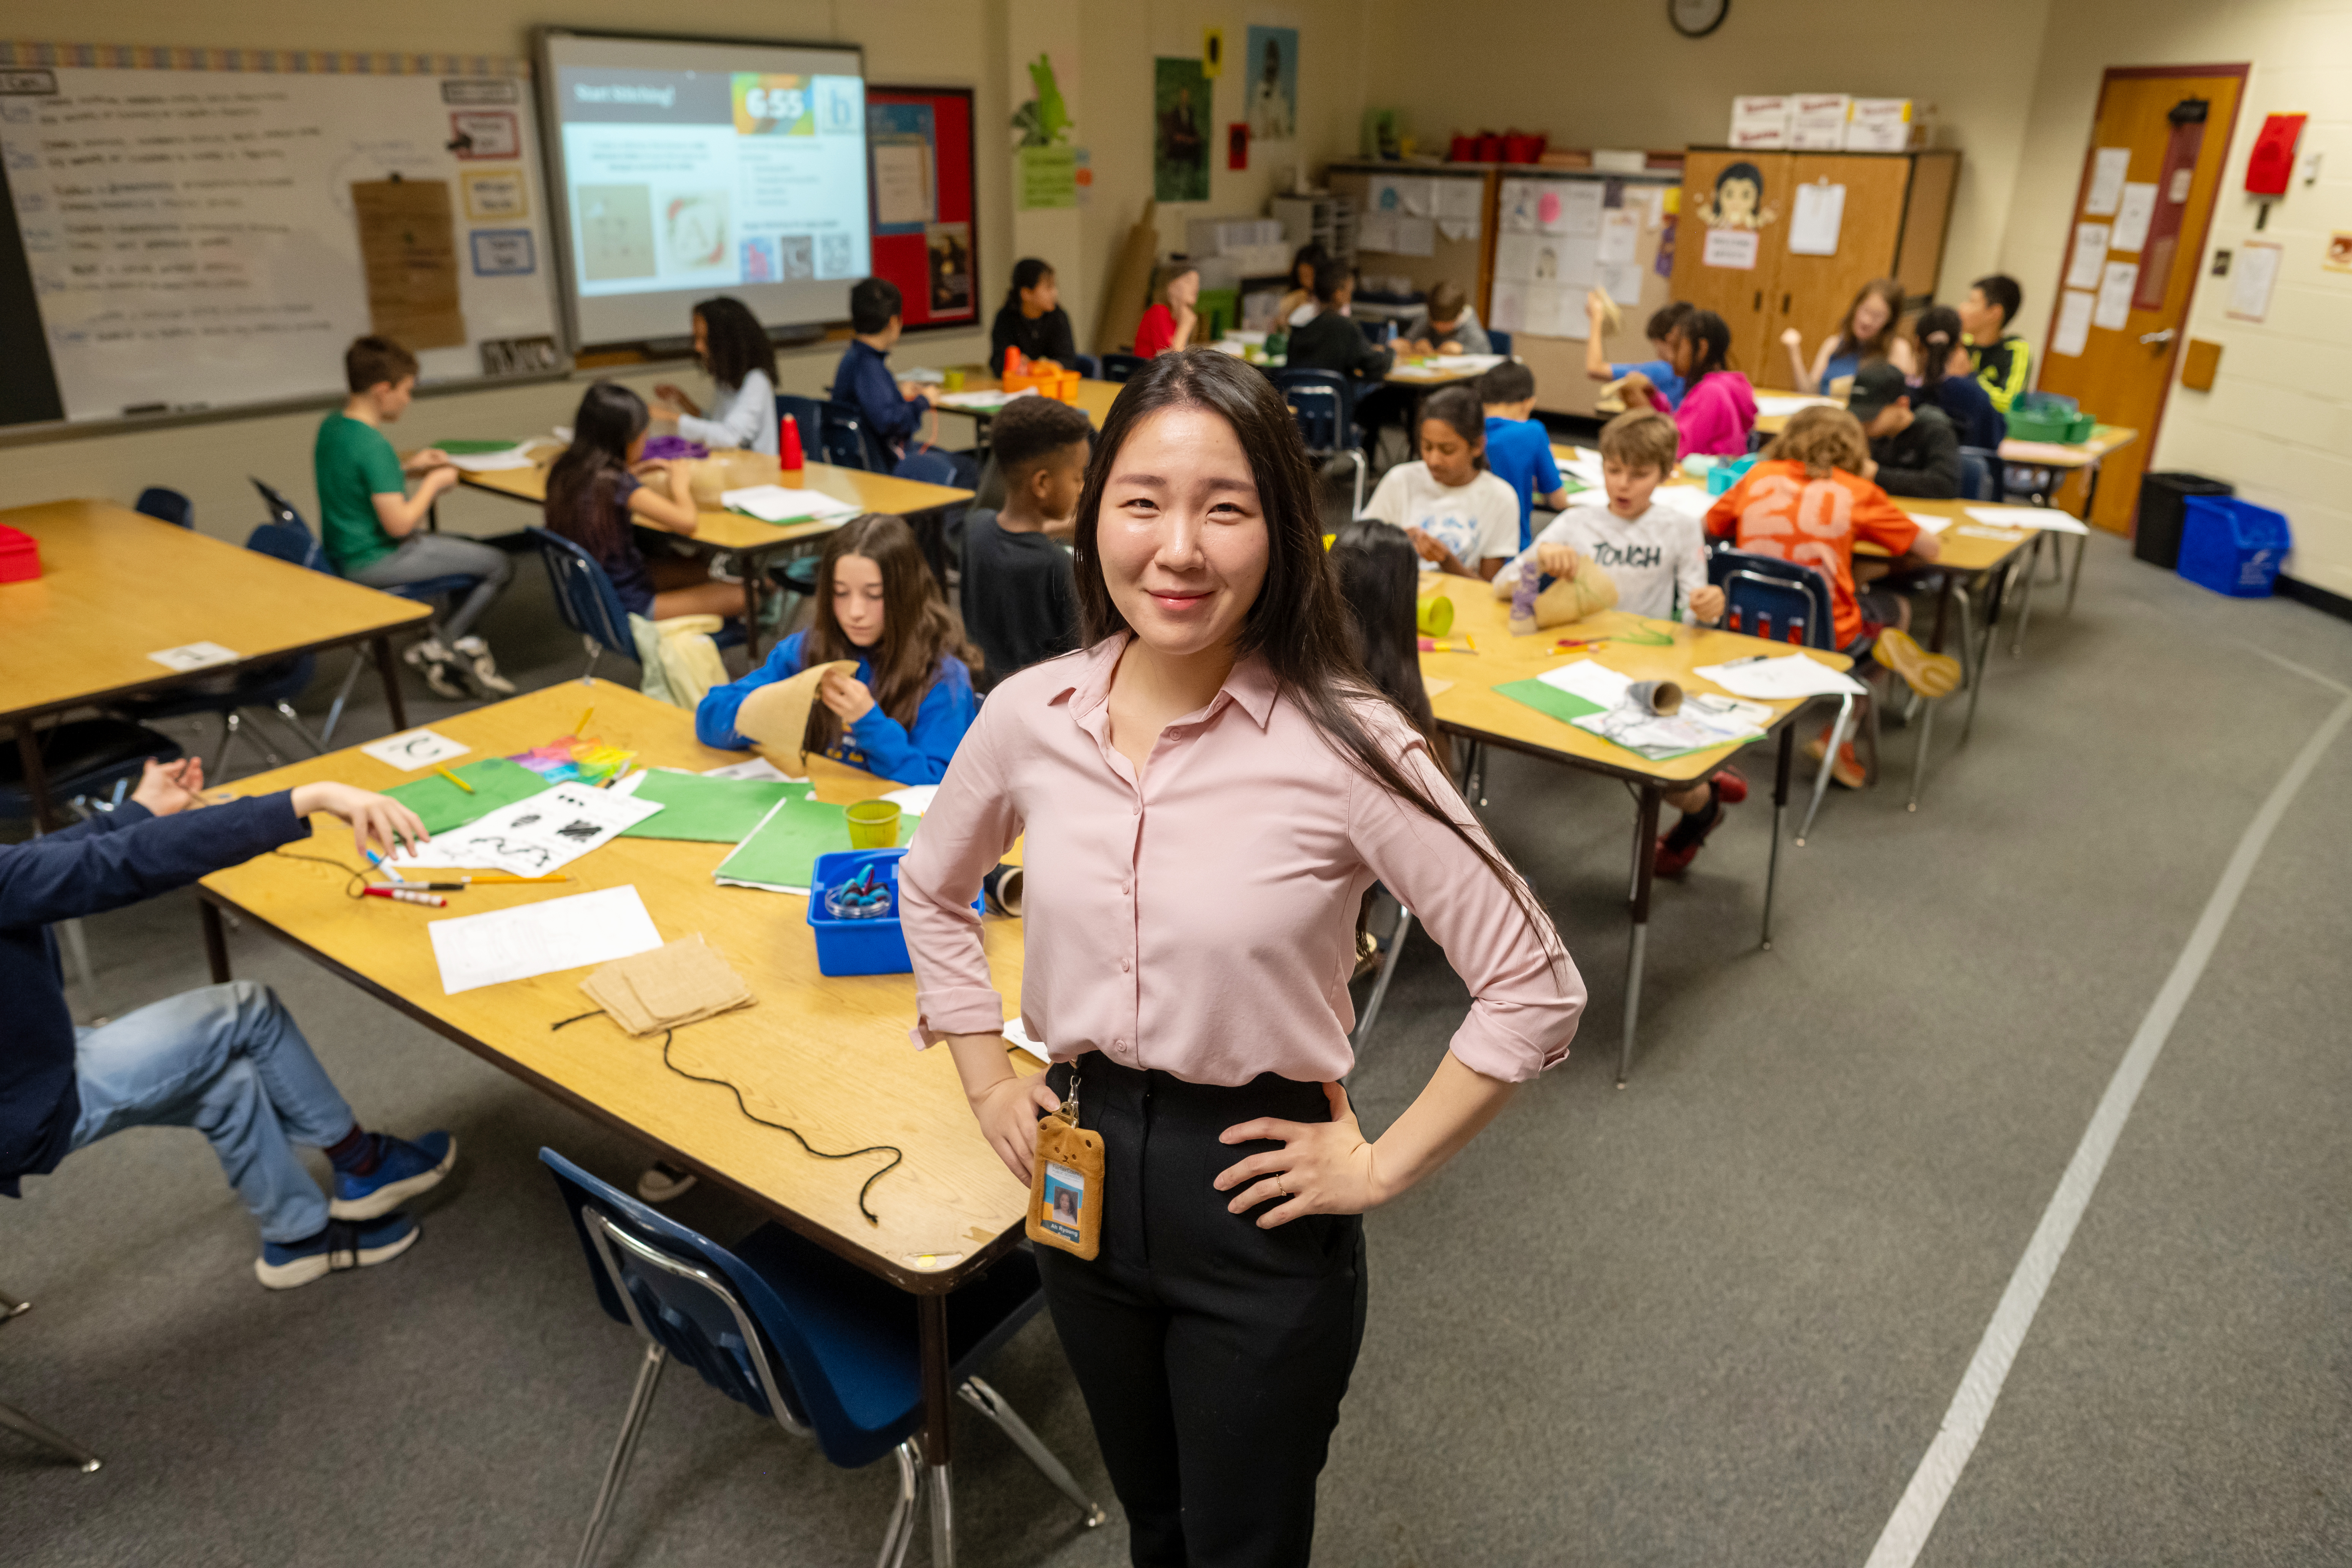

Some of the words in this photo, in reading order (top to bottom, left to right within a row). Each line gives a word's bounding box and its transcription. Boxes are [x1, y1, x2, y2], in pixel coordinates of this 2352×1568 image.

[1742, 474, 1853, 539] 20
[1593, 541, 1661, 567] TOUGH
[1059, 1226, 1078, 1237] Ryoung
